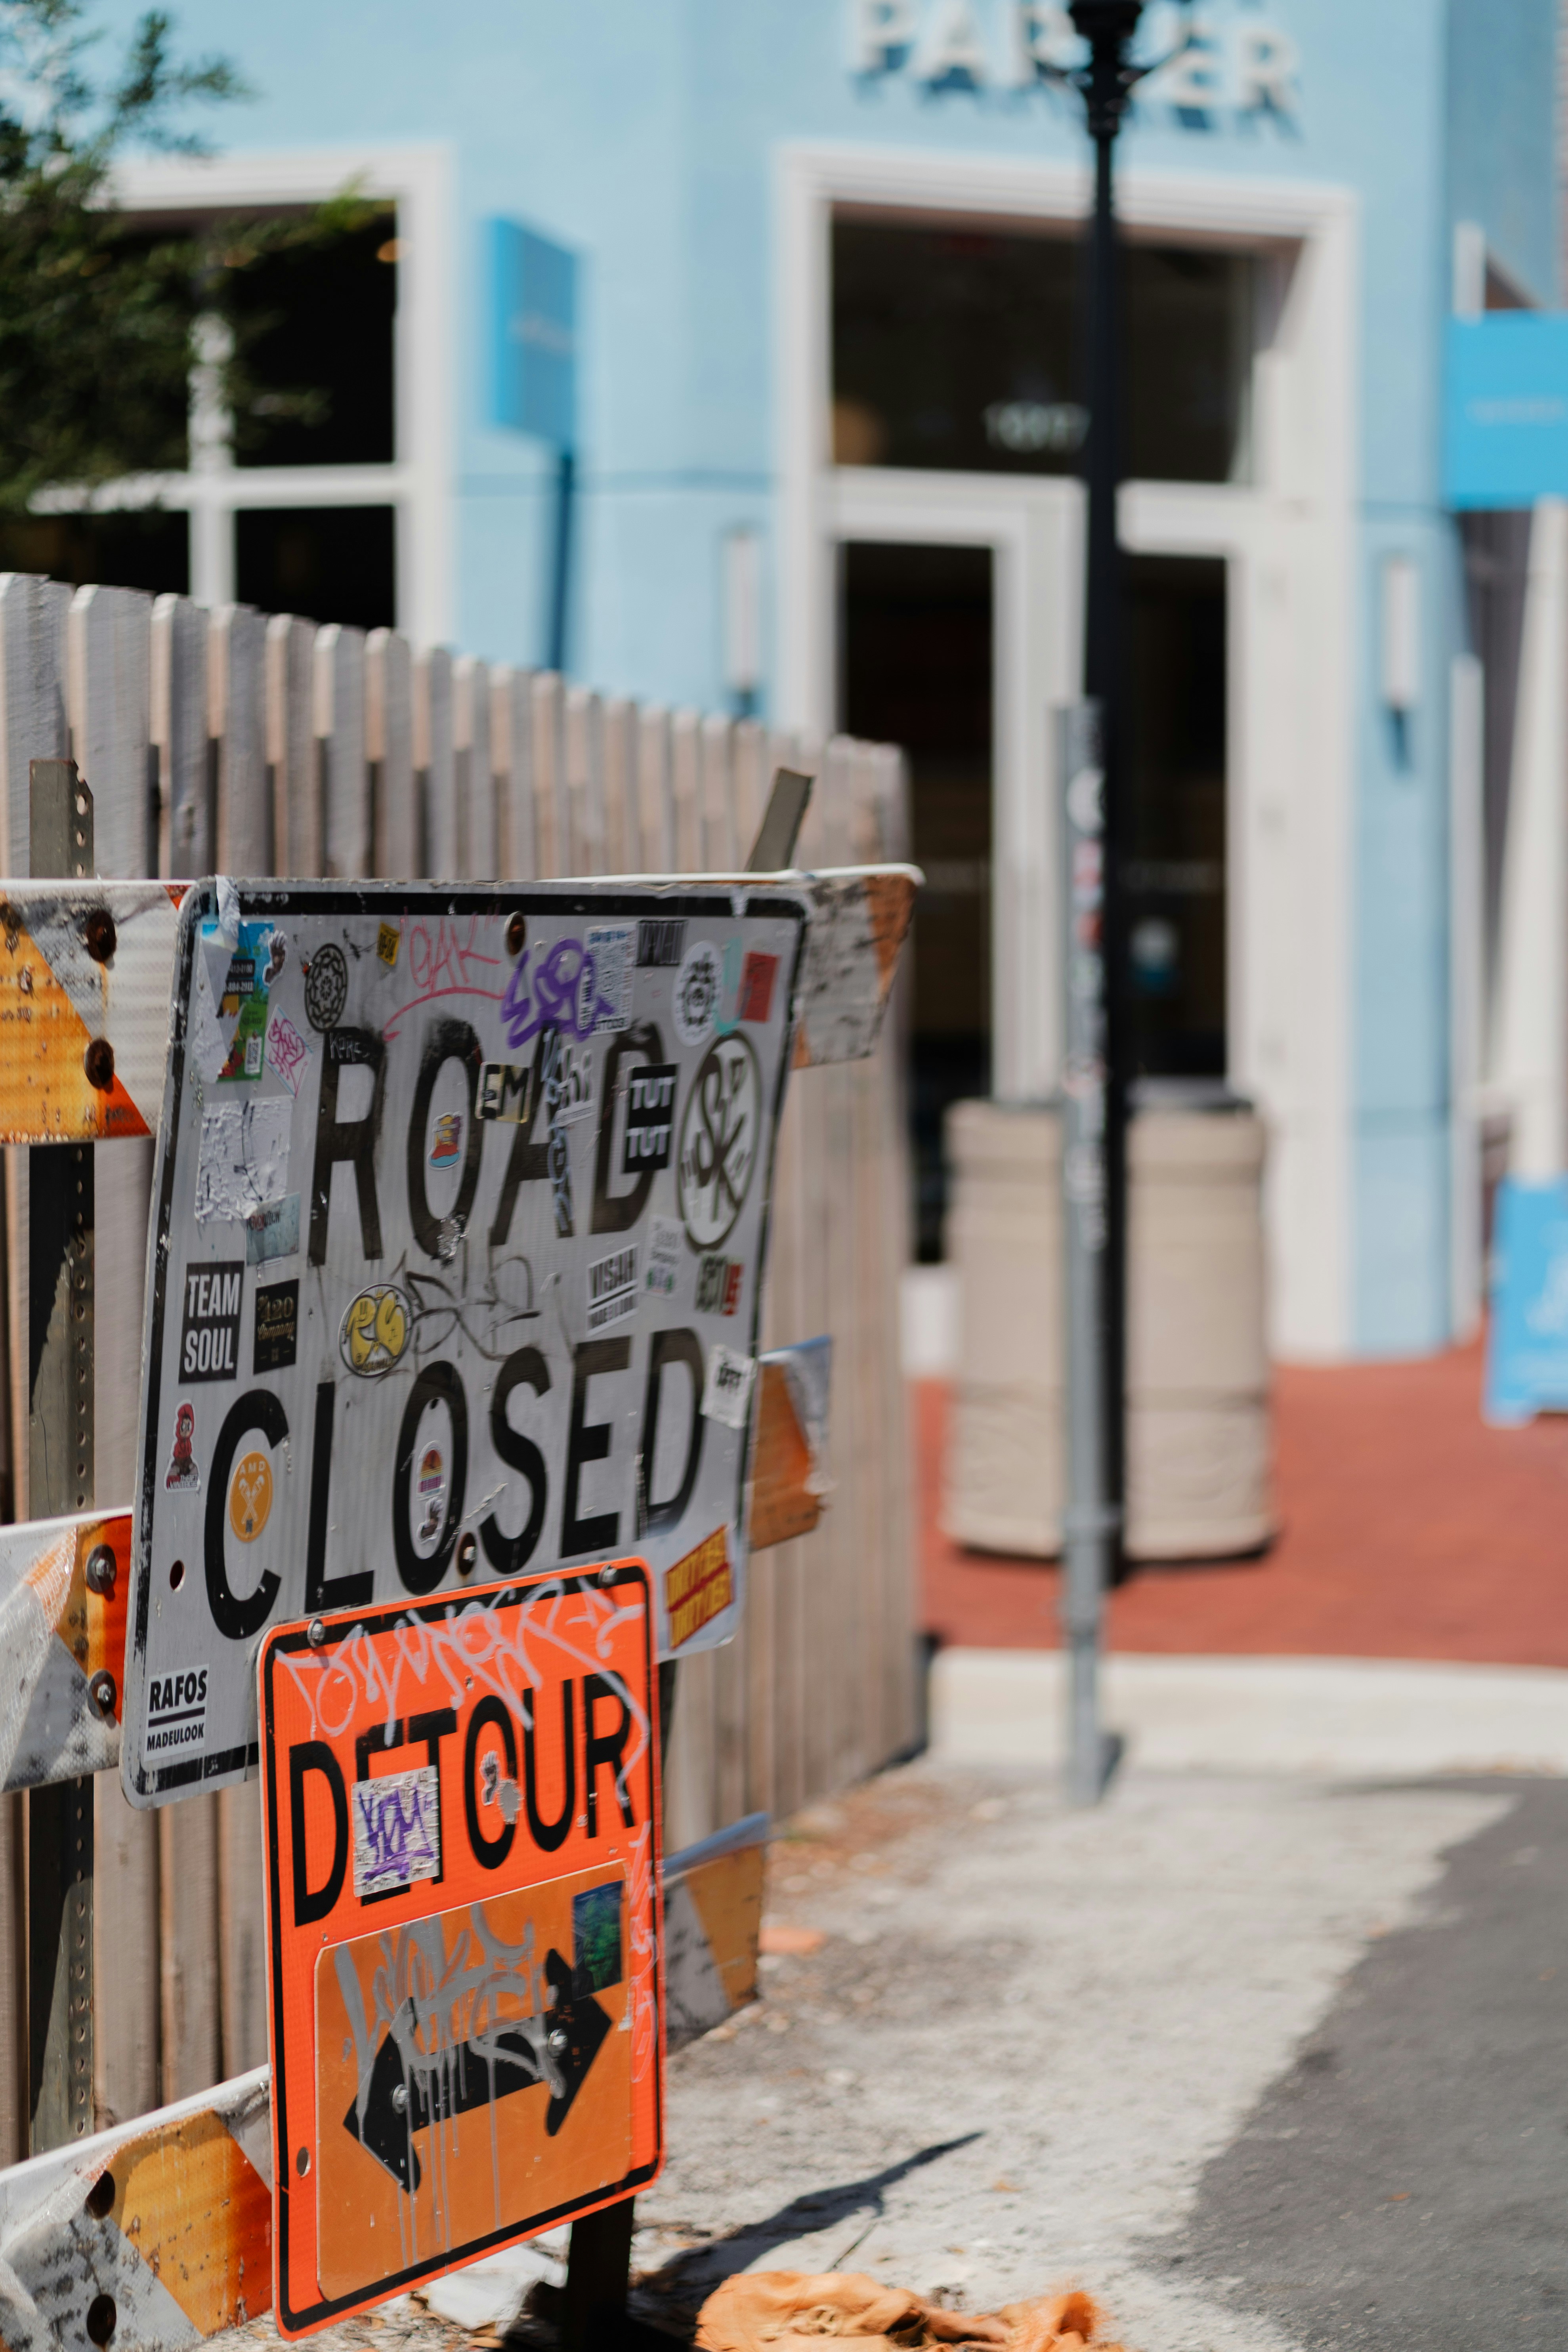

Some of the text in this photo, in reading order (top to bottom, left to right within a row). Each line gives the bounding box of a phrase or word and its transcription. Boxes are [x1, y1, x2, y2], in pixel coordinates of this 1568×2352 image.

[630, 1075, 677, 1109] TUT
[309, 1019, 666, 1266] ROAD
[626, 1123, 673, 1158] TUT
[188, 1272, 240, 1319] TEAM
[260, 1296, 294, 1323] 420
[184, 1327, 234, 1374] SOUL
[258, 1321, 295, 1342] Company
[204, 1327, 705, 1640] CLOSED
[239, 1460, 266, 1476] AMD
[149, 1669, 208, 1713] RAFOS
[147, 1723, 204, 1751] MADEULOOK
[288, 1670, 635, 1927] DETOUR
